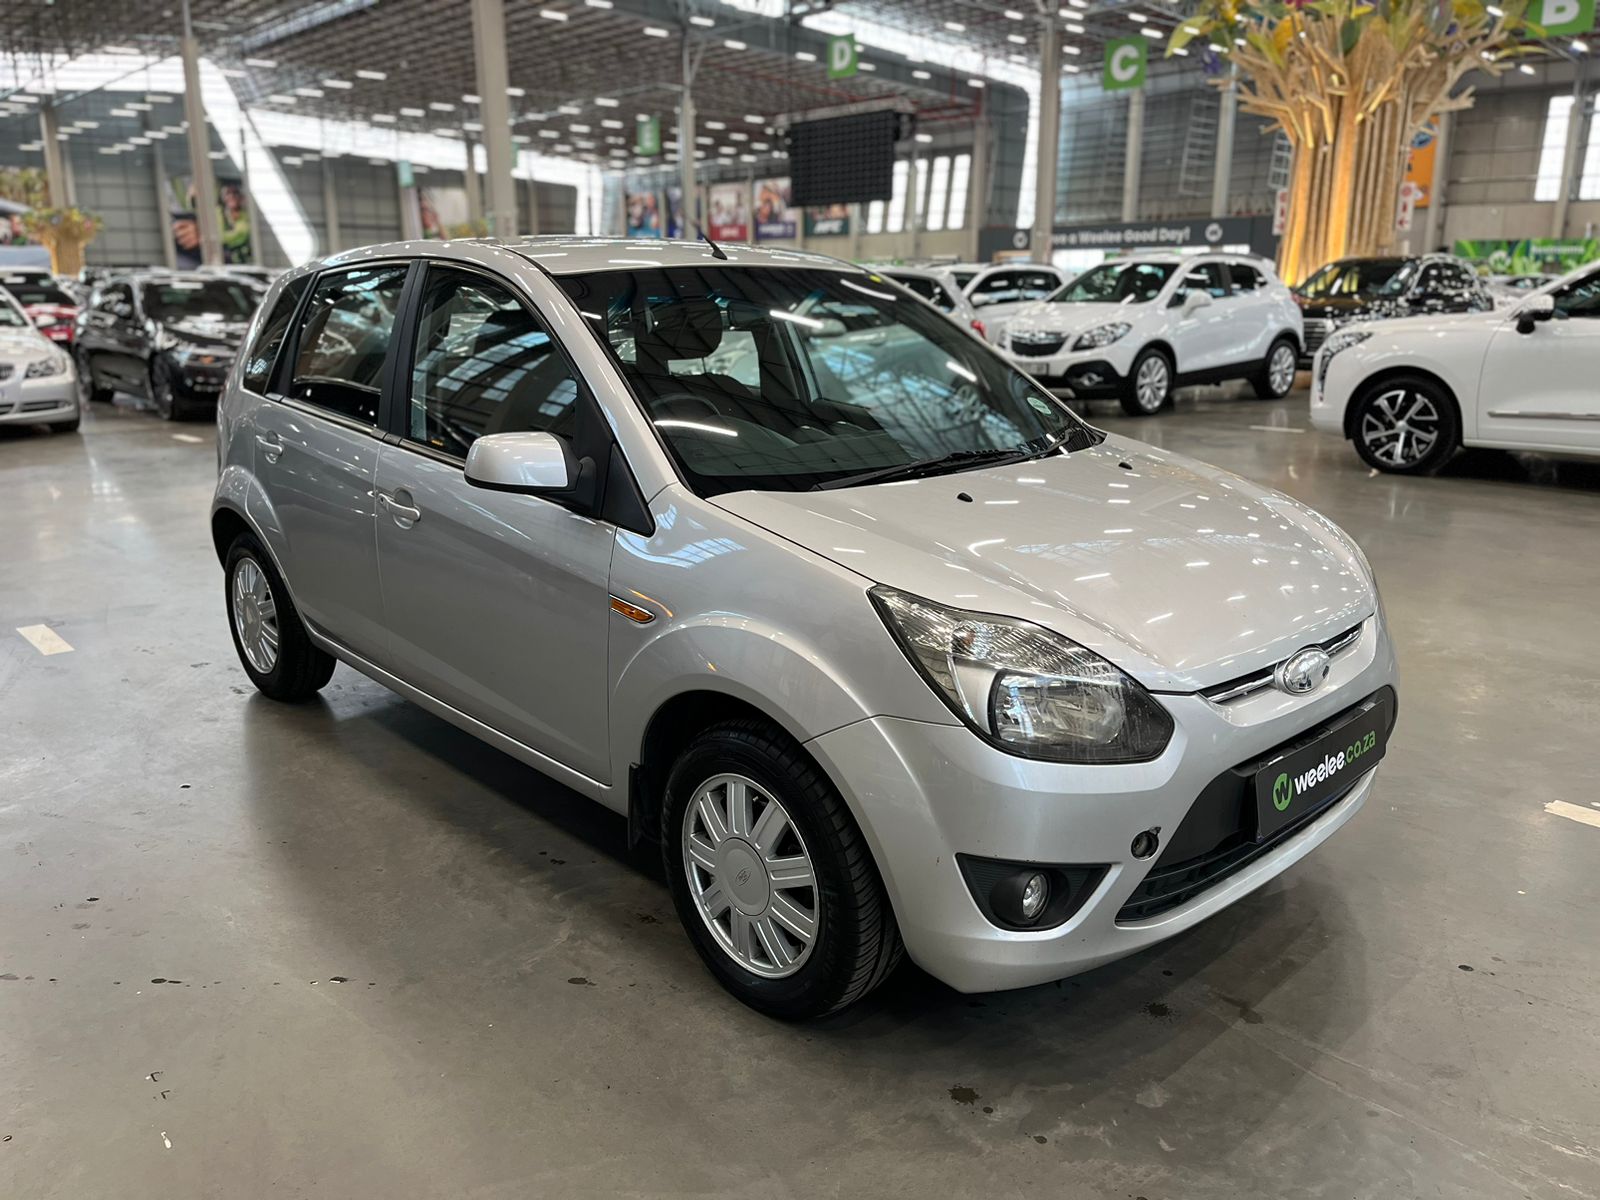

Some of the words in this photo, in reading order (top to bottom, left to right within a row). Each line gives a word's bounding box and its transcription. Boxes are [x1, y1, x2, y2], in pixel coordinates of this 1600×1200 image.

[832, 40, 852, 70] D
[1110, 44, 1139, 82] C
[1079, 229, 1122, 244] Weelee
[1123, 228, 1158, 243] Good
[1159, 226, 1191, 244] Day!
[1294, 730, 1376, 795] weelee.co.za
